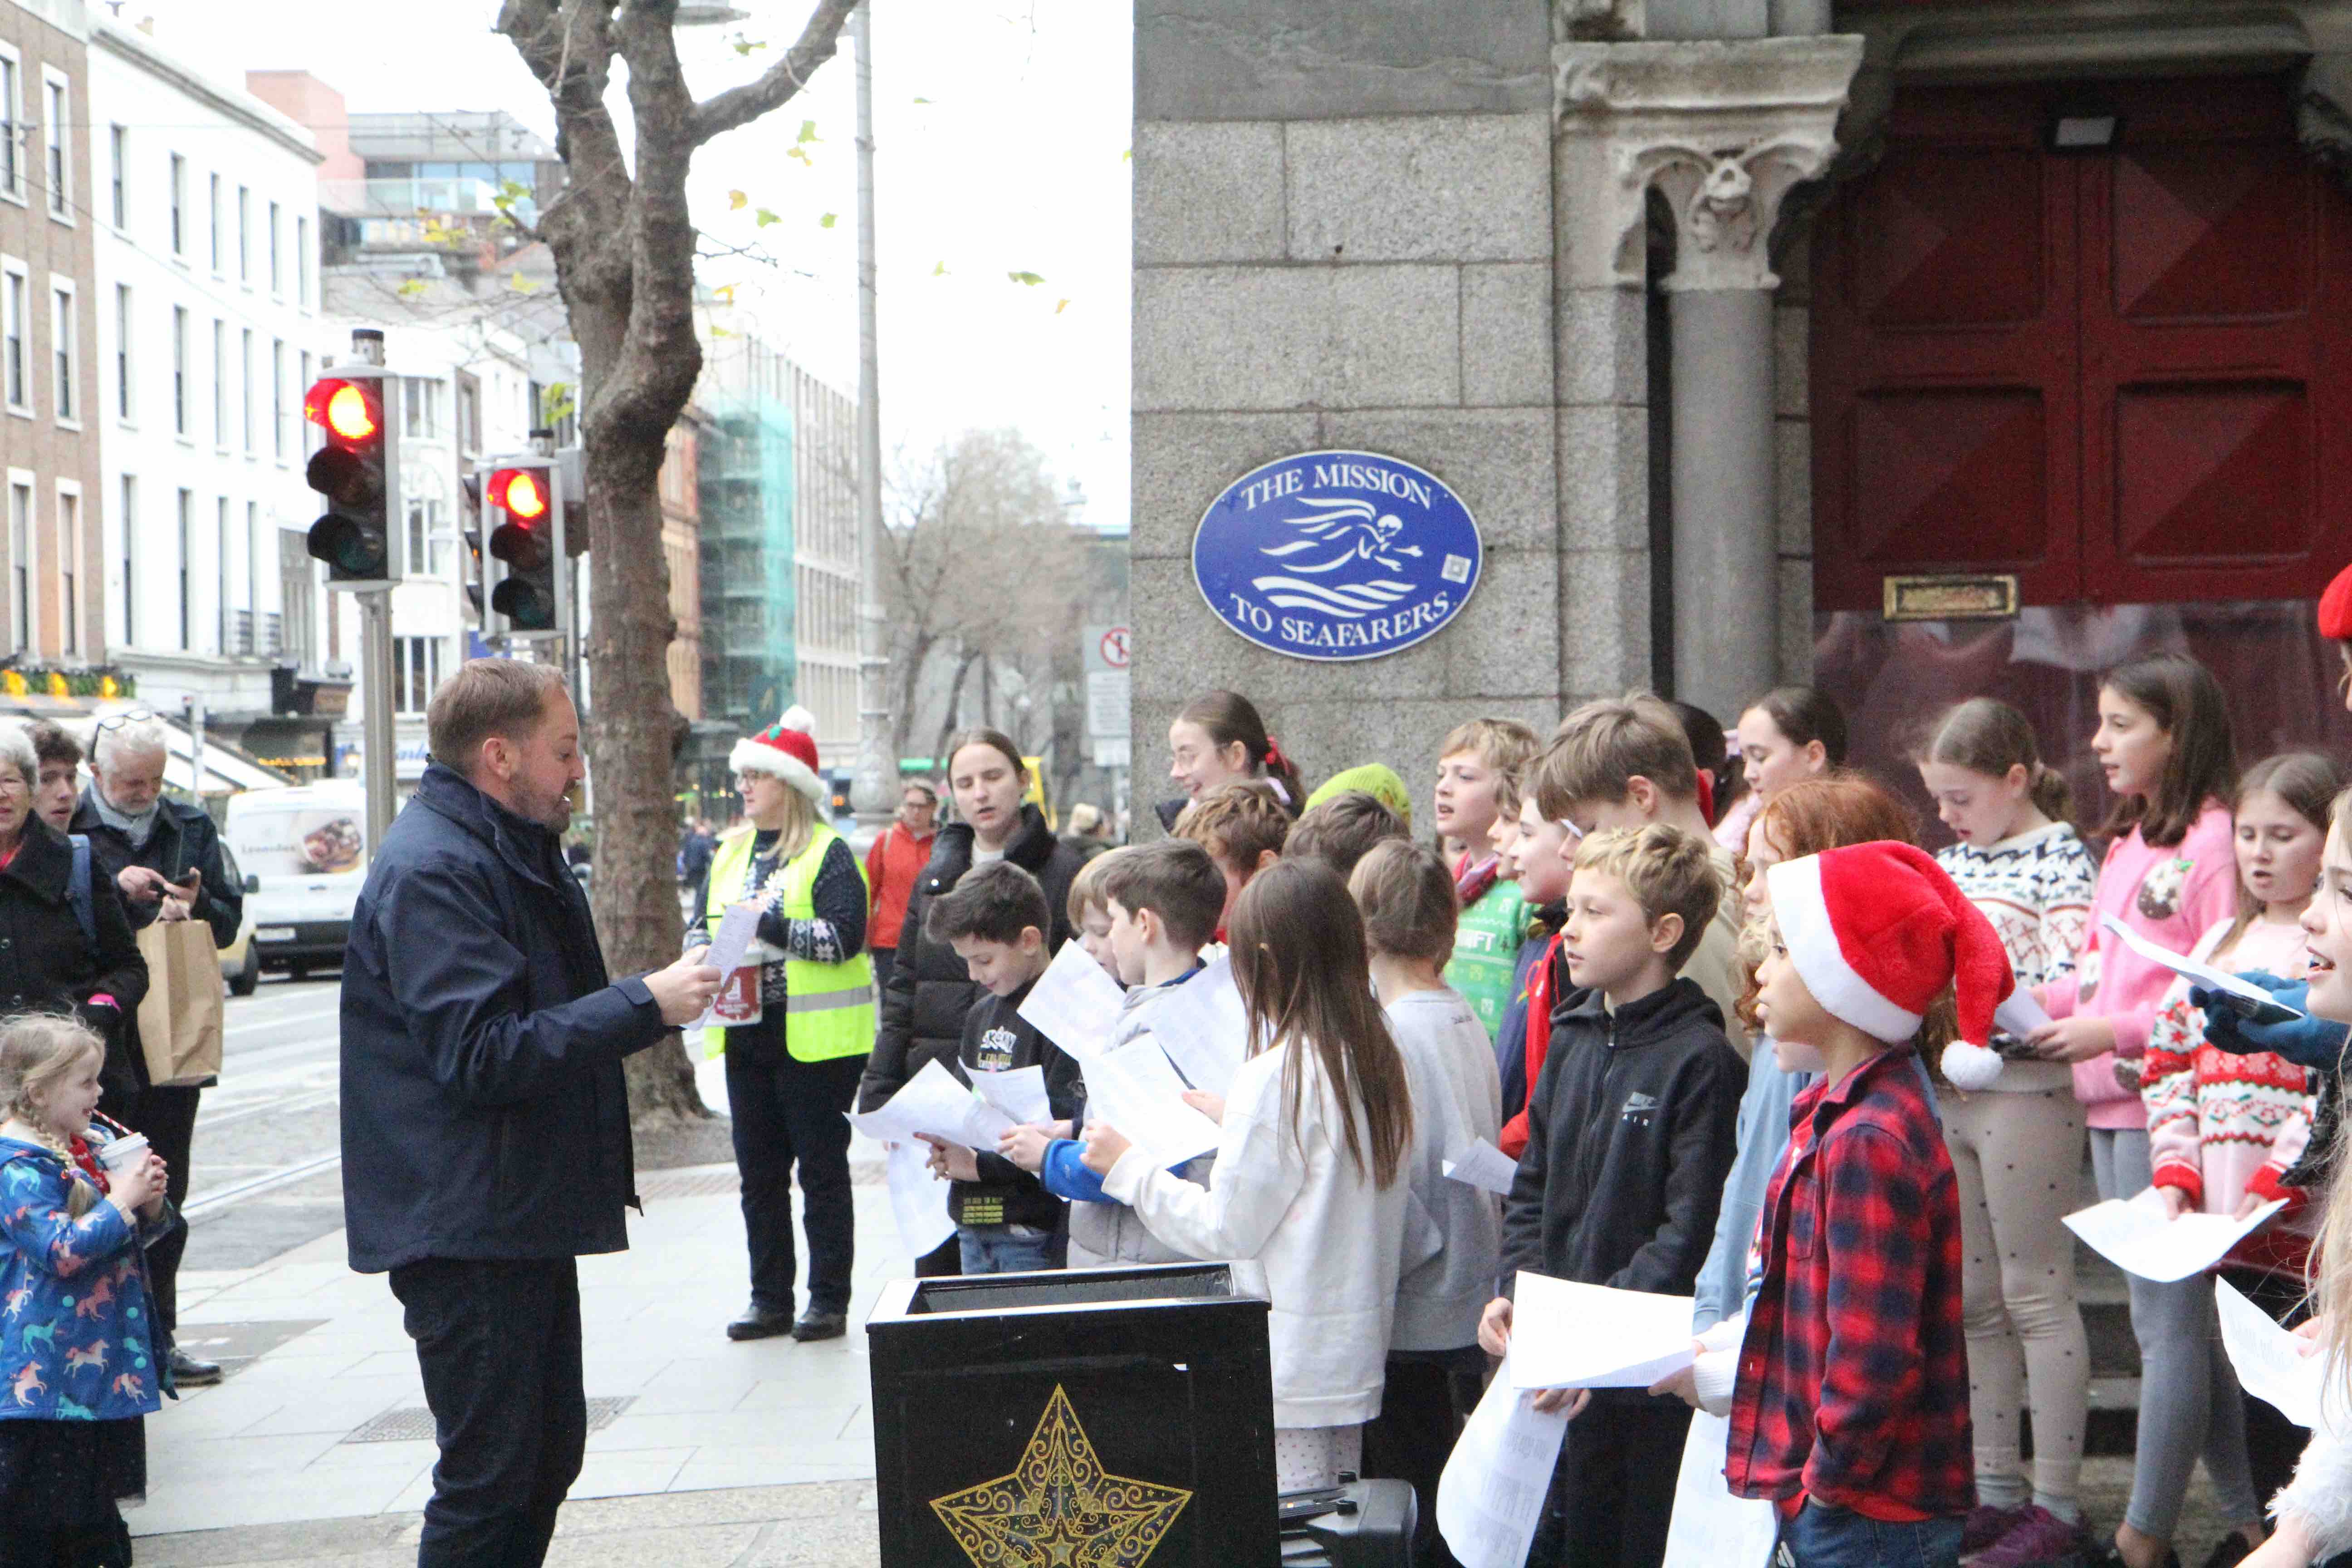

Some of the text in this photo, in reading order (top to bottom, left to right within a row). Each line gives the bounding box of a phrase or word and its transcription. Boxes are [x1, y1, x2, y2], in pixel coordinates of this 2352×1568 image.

[1241, 464, 1432, 511] THE MISSION
[1230, 591, 1449, 647] TO SEAFARERS
